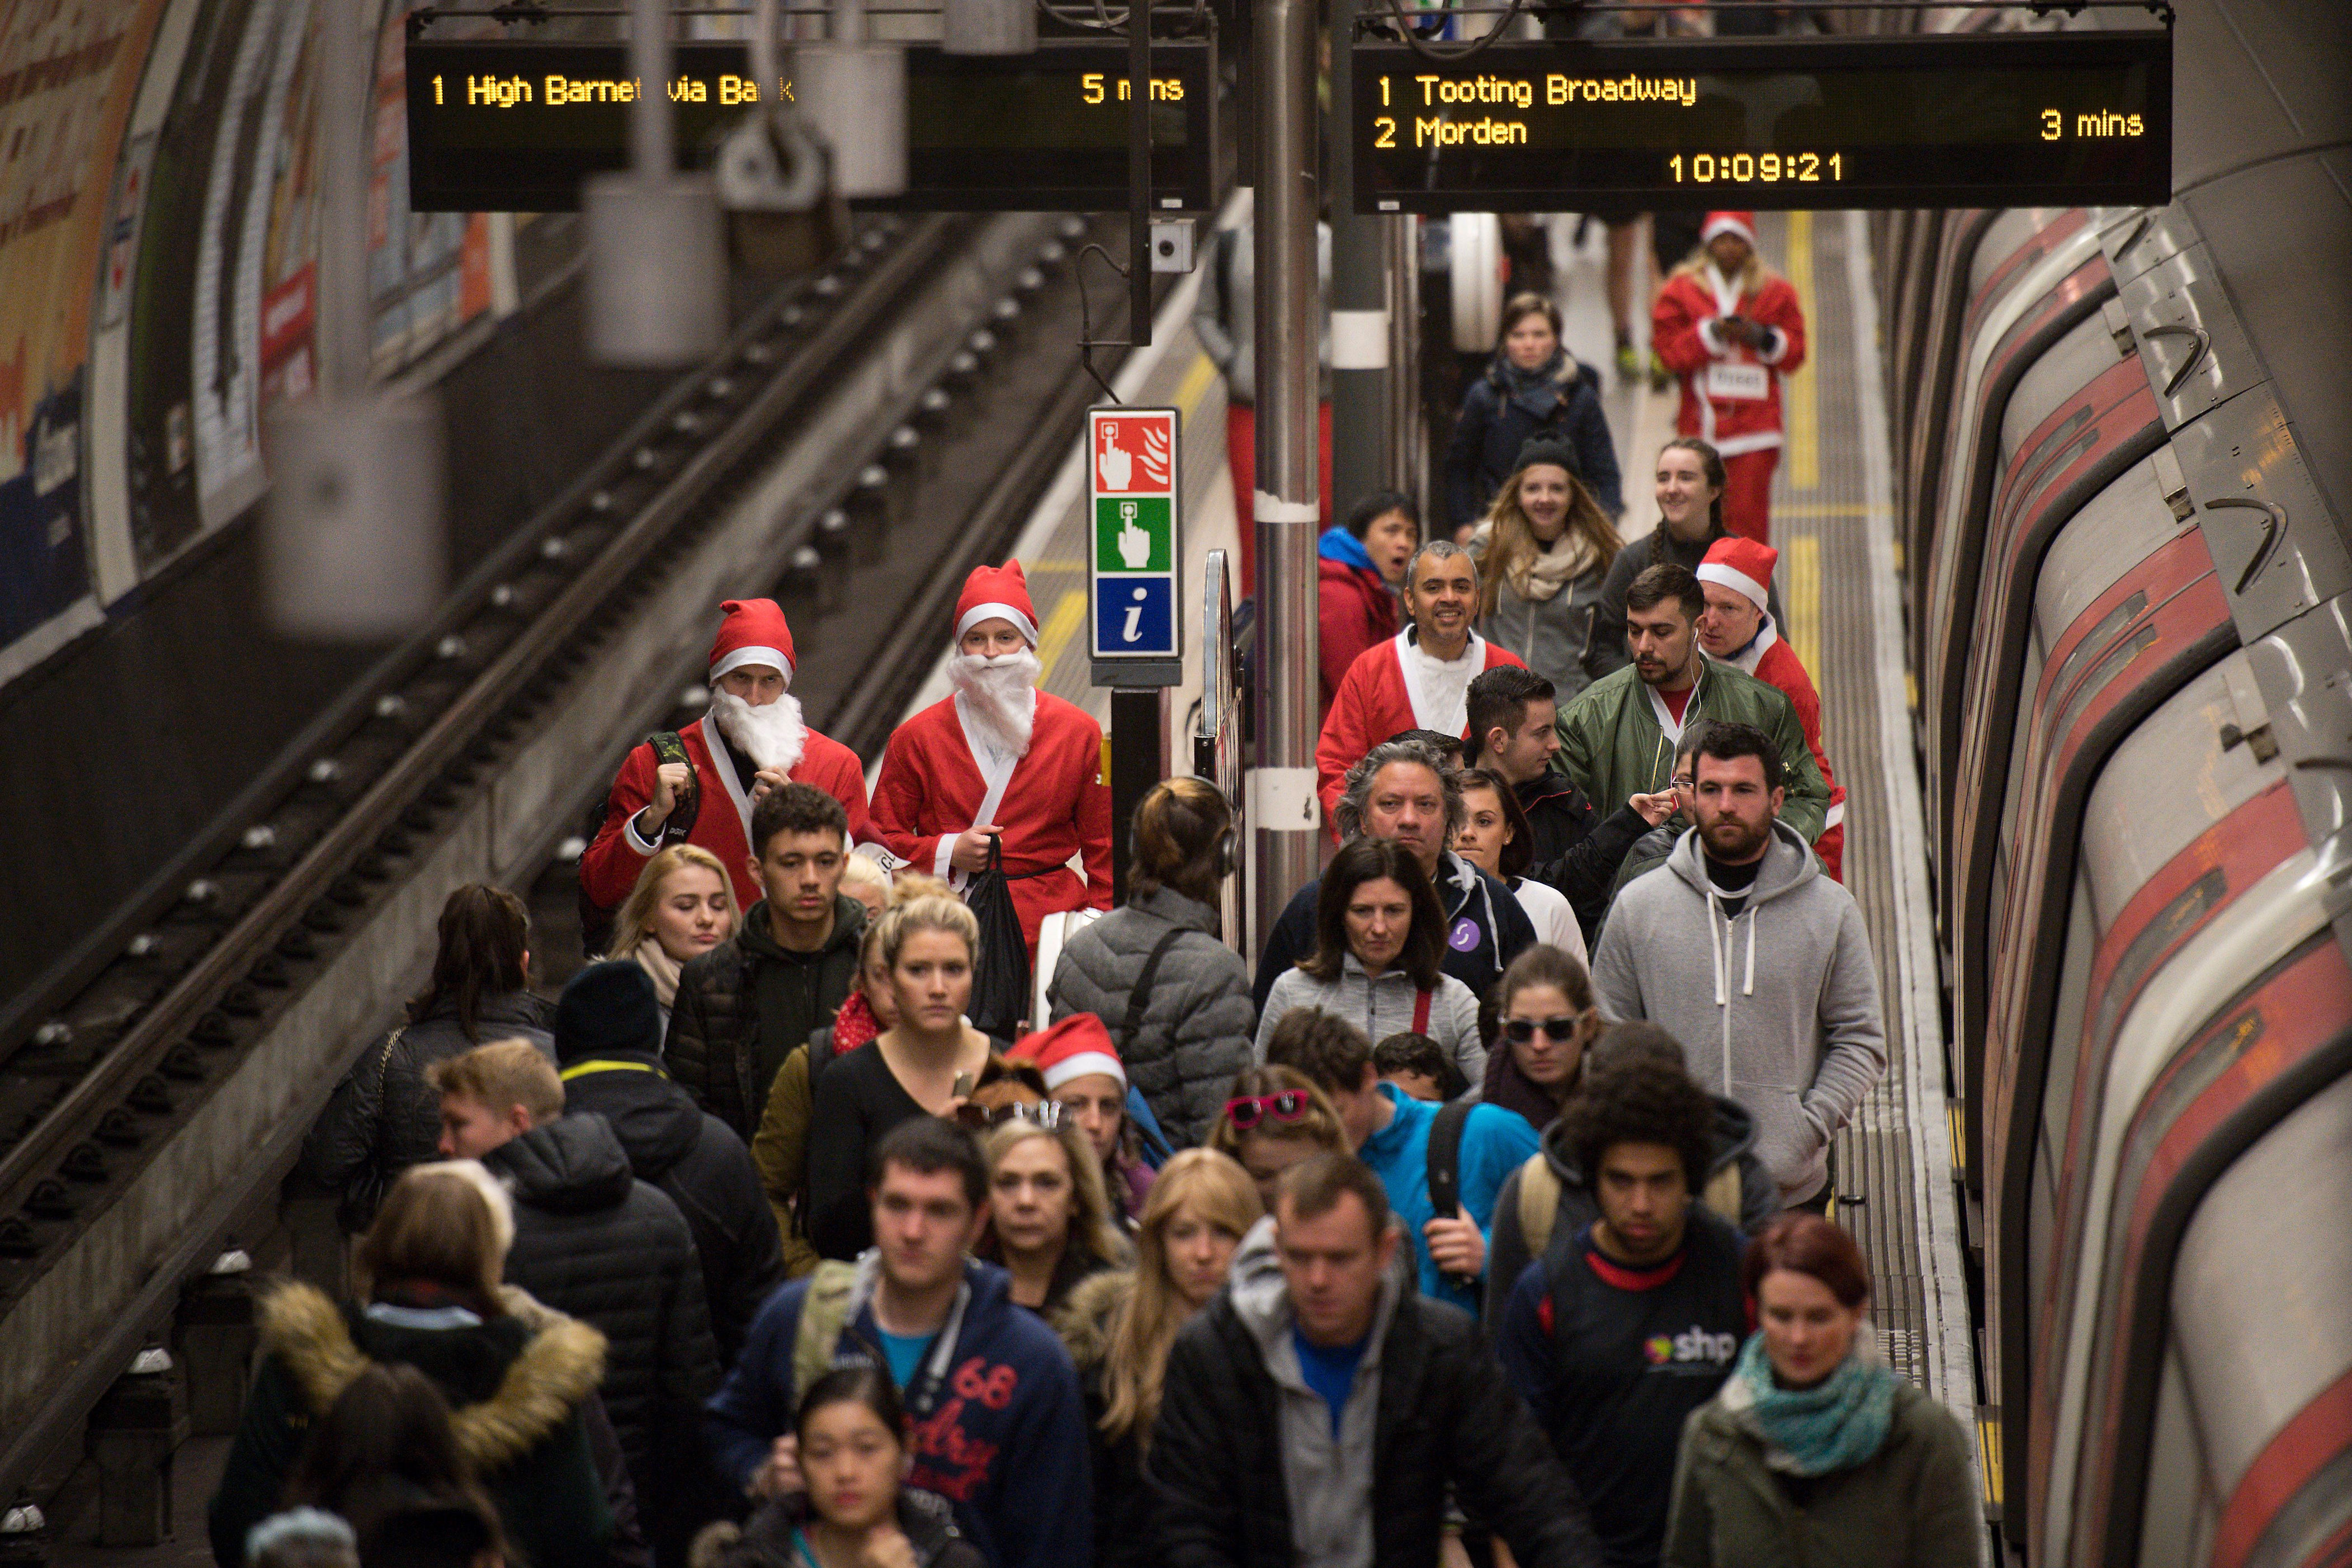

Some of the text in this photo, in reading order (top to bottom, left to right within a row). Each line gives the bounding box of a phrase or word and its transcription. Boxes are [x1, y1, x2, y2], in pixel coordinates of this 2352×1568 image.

[432, 74, 443, 105] 1
[467, 75, 532, 108] High
[667, 75, 707, 102] via
[719, 75, 795, 105] Bak
[1082, 73, 1104, 104] 5
[1117, 79, 1184, 101] mns
[1379, 73, 1697, 108] 1 Tooting Broadway
[1374, 108, 2144, 148] 2 Morden 3 mins
[1669, 152, 1842, 183] 10:09:21
[1673, 1325, 1737, 1366] shp
[952, 1355, 1019, 1410] 68
